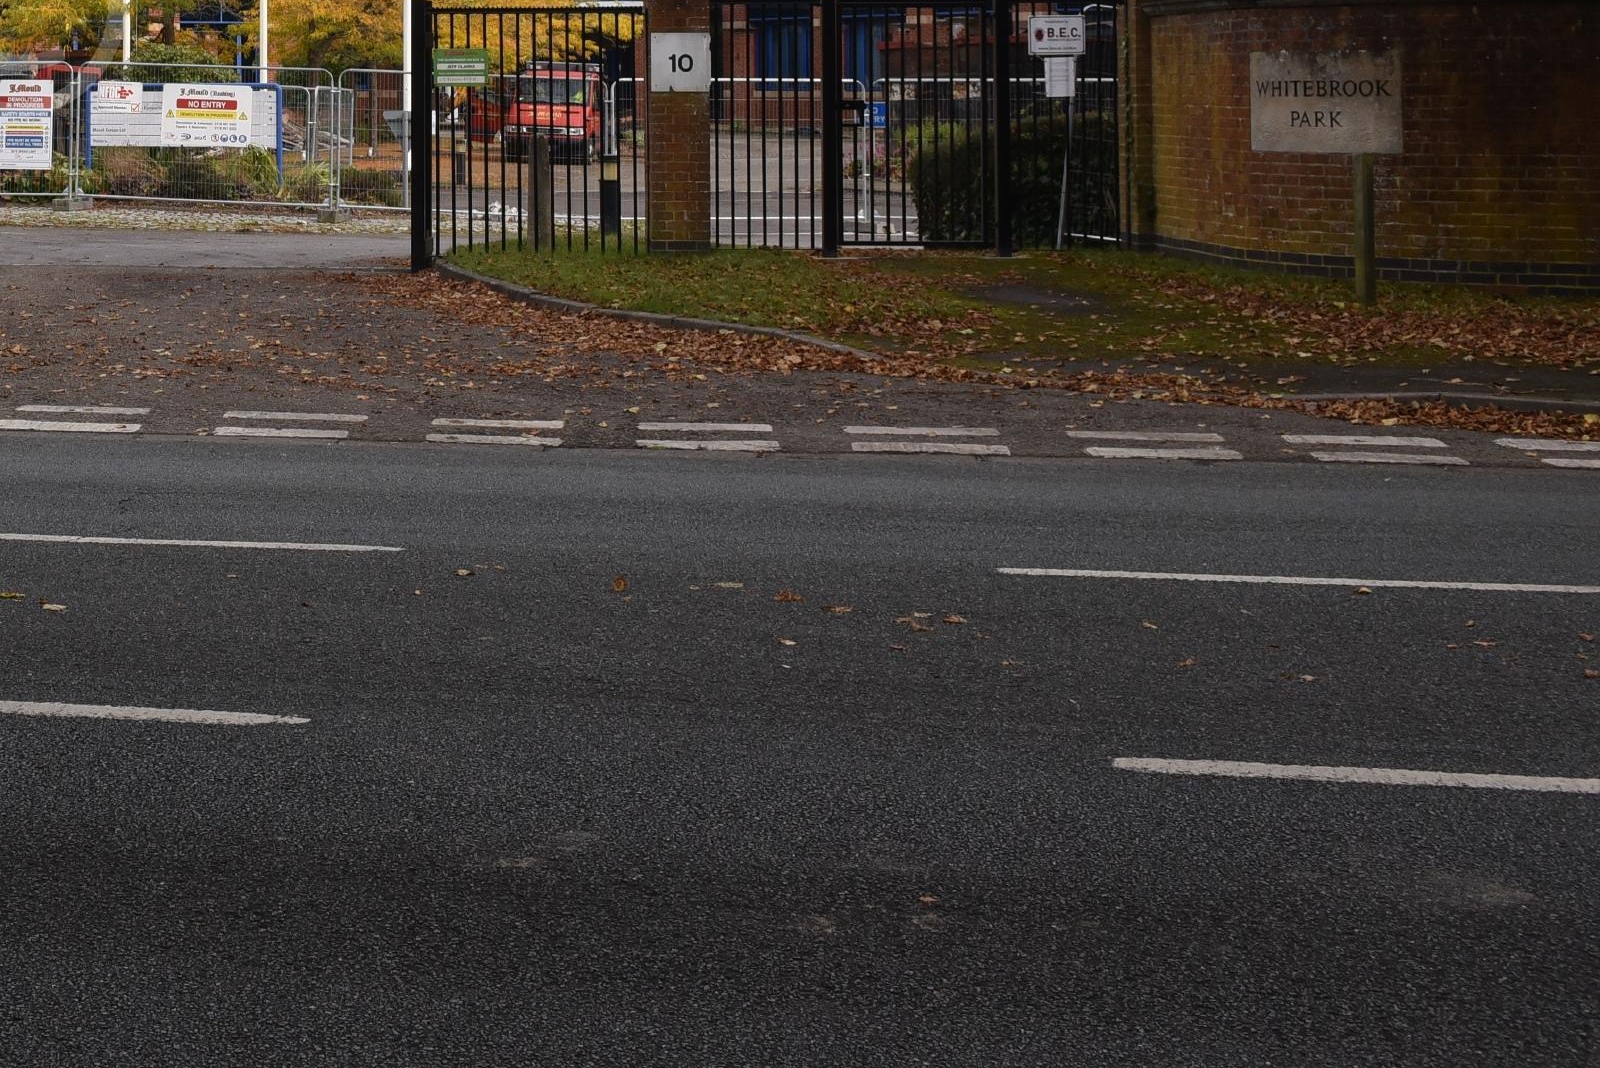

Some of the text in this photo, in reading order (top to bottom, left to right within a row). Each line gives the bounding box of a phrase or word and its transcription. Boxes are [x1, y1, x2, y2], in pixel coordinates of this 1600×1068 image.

[1047, 27, 1081, 38] B.E.C.
[668, 53, 694, 73] 10
[1256, 80, 1392, 98] WHITEBROOK
[1290, 110, 1344, 128] PARK
